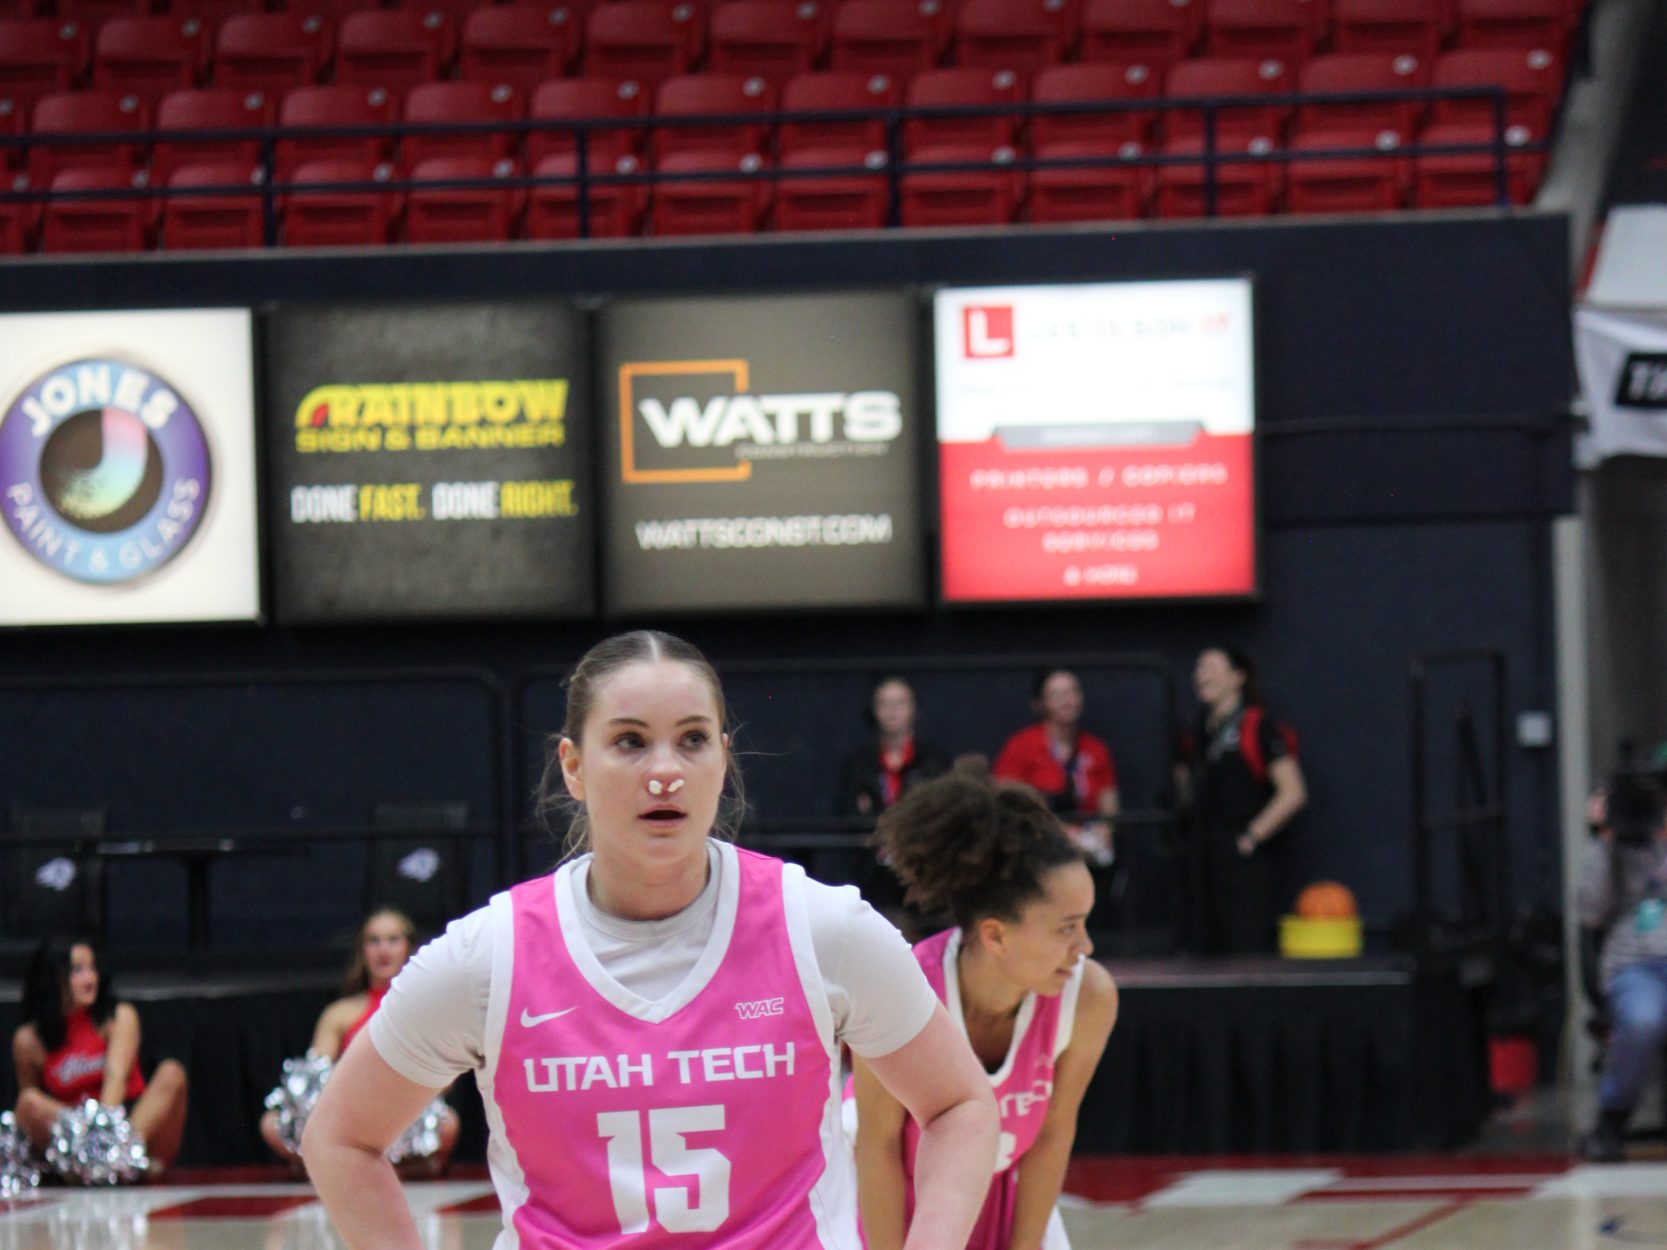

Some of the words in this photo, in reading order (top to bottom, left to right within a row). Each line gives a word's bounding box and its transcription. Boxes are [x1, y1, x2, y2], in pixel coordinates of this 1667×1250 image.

[21, 364, 178, 437] JONES
[295, 378, 568, 428] RAINBOW
[638, 390, 902, 448] WATTS
[295, 426, 382, 452] SIGN
[415, 421, 565, 450] BANNER
[7, 481, 80, 566] PAINT
[88, 549, 110, 574] &
[118, 477, 201, 570] GLASS
[291, 484, 357, 523] DONE
[432, 481, 499, 519] DONE
[735, 997, 785, 1020] WAC
[523, 1053, 653, 1093] UTAH
[667, 1041, 796, 1085] TECH
[596, 1104, 732, 1236] 15
